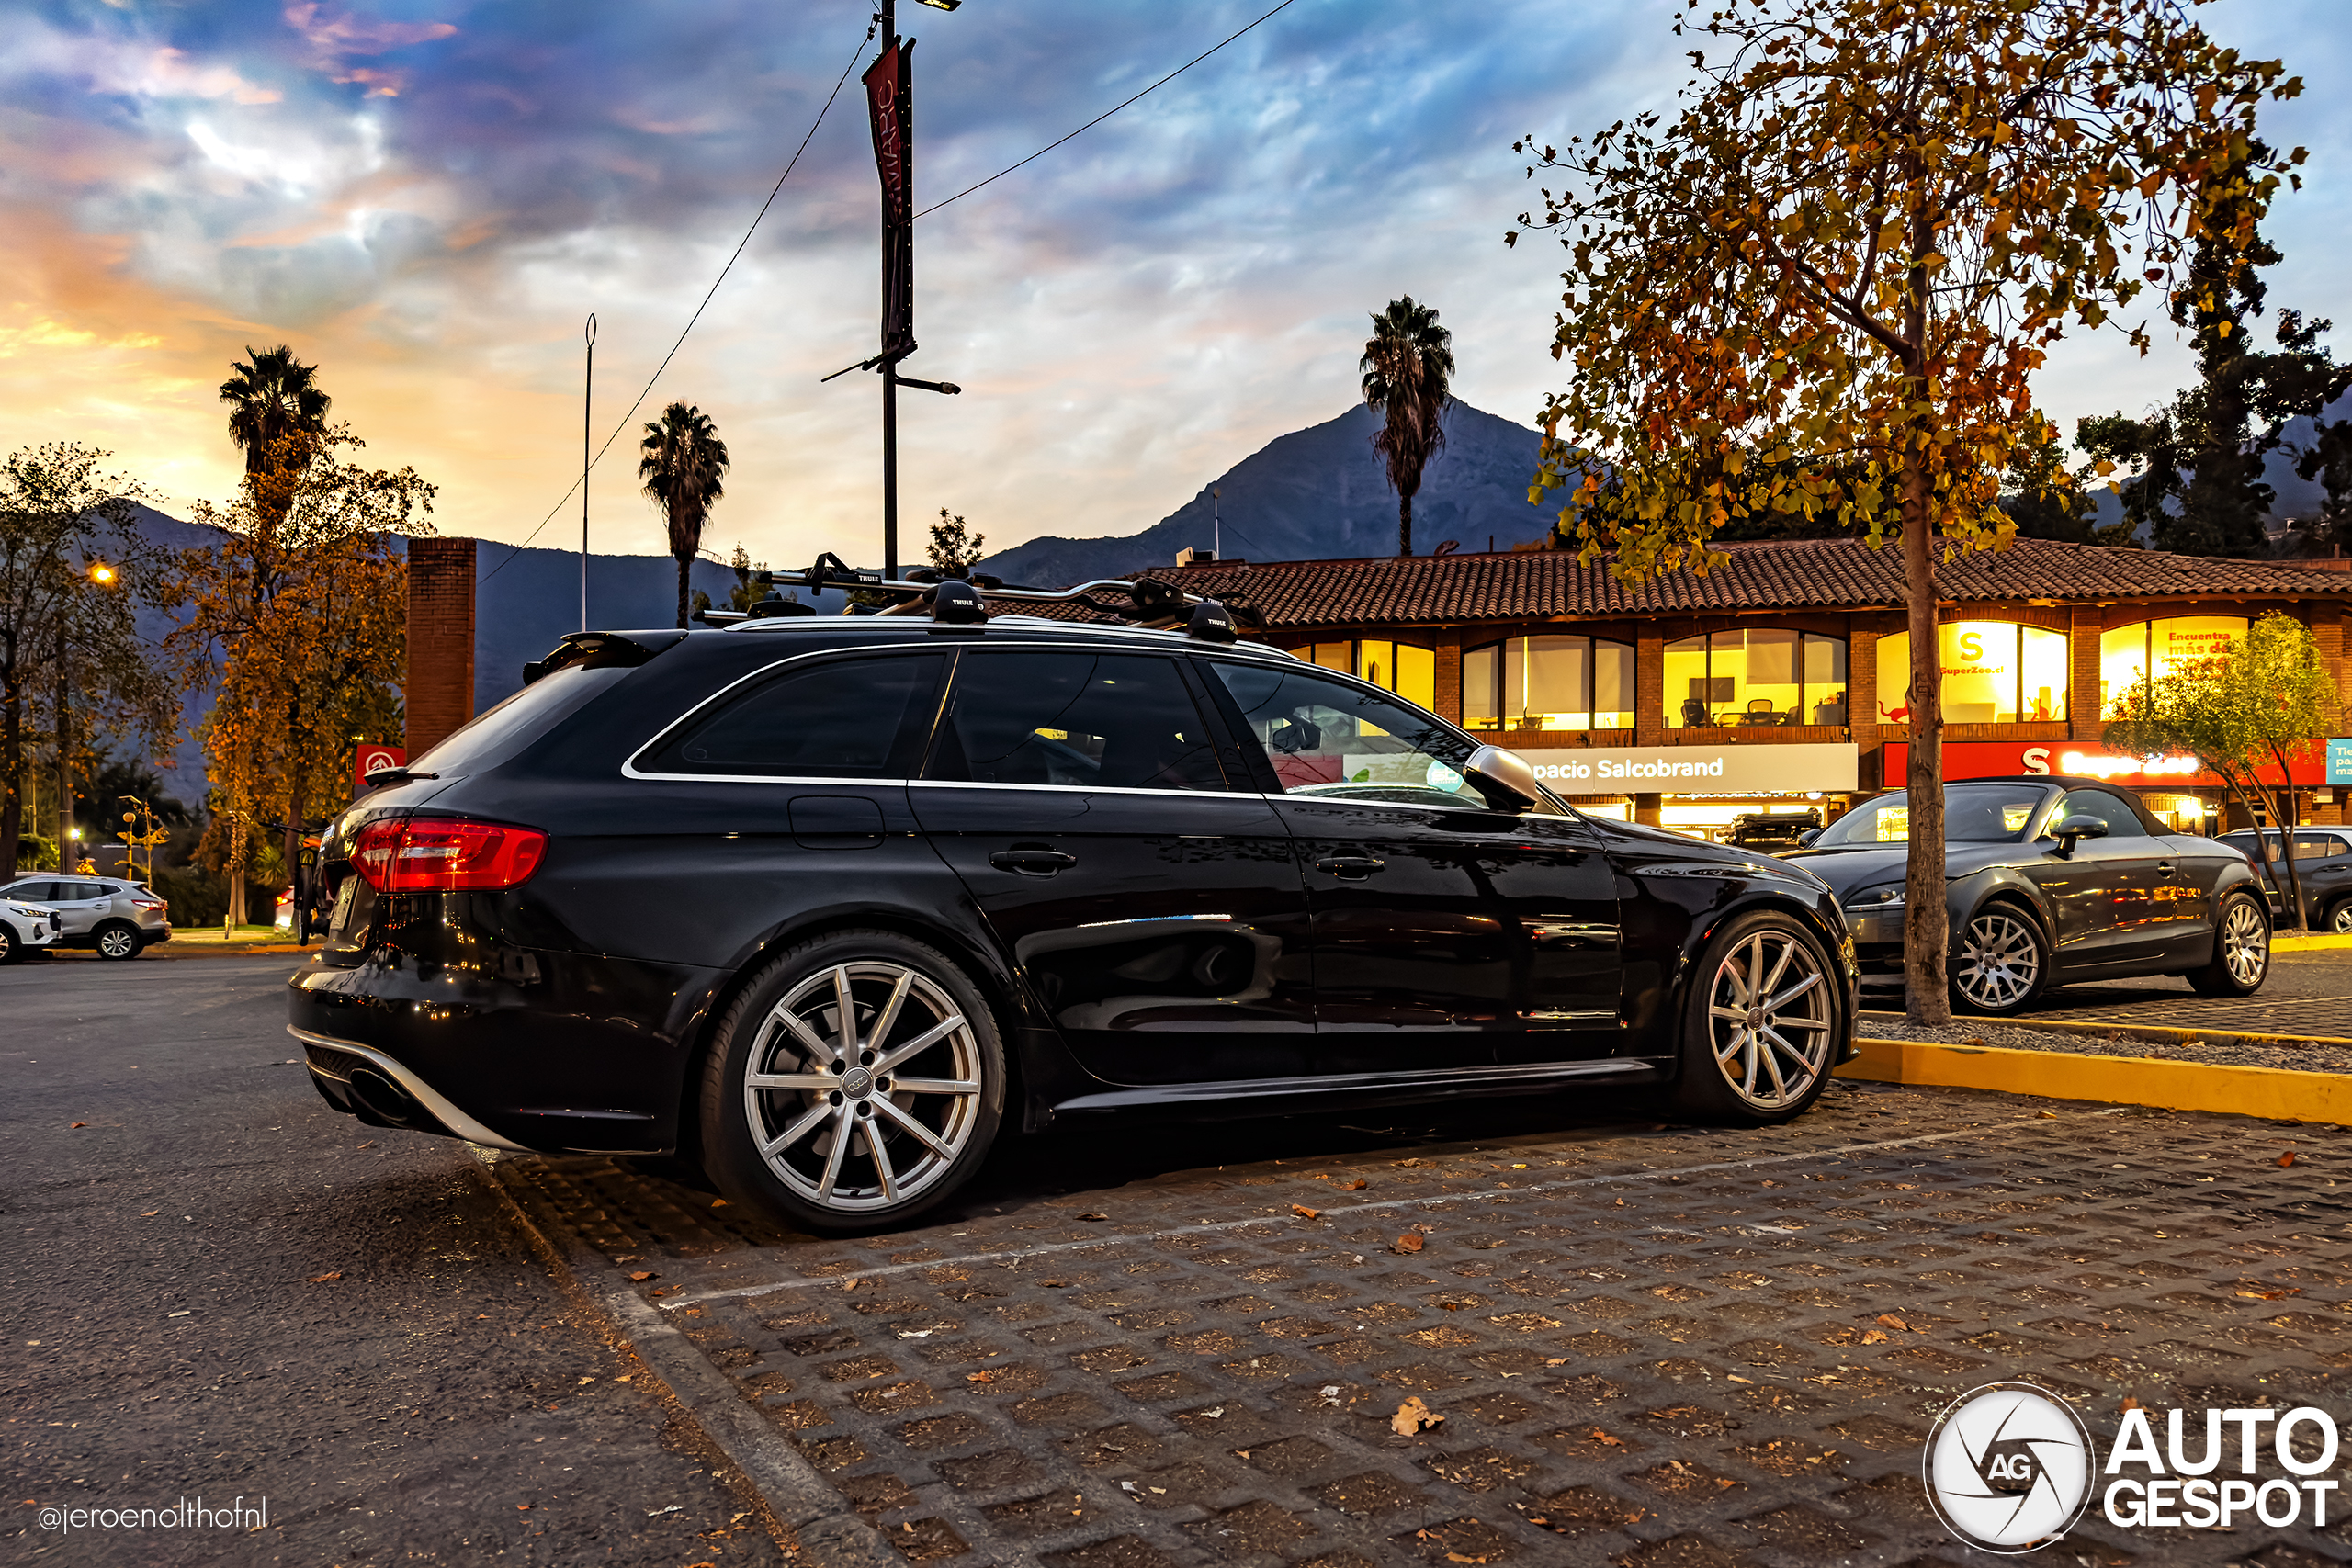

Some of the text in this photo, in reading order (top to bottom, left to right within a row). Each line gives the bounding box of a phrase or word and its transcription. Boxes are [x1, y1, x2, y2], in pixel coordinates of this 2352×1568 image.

[1207, 597, 1224, 607] THULE
[1207, 618, 1227, 626] THULE
[2168, 632, 2231, 641] Encuentra
[1959, 631, 1984, 662] S
[2168, 642, 2205, 655] más
[1940, 666, 2004, 676] SuperZoo.cl
[1532, 757, 1724, 779] pacio Salcobrand
